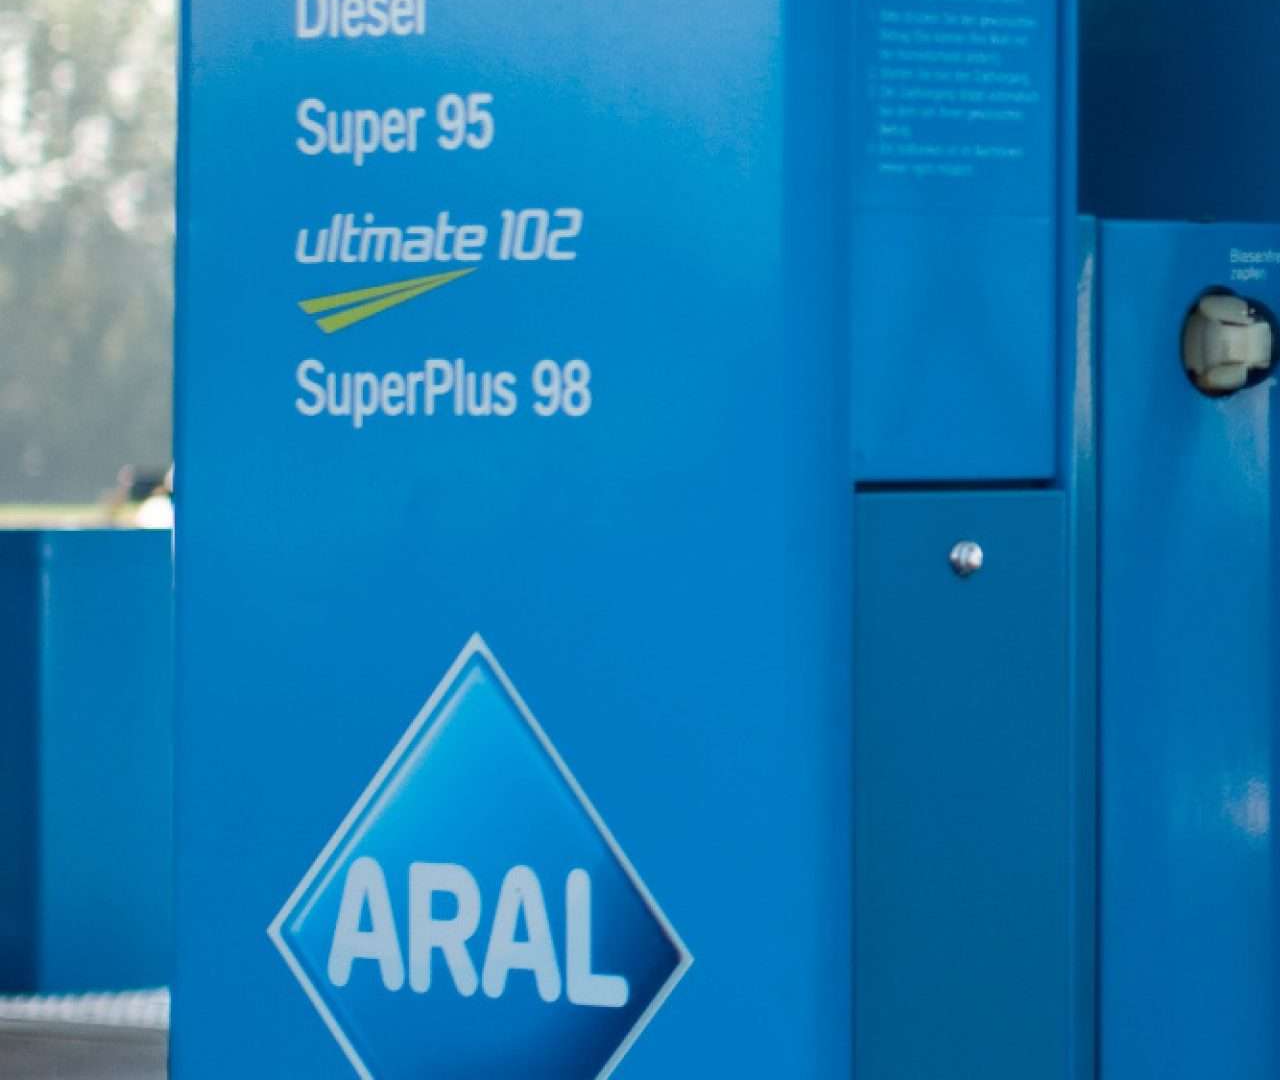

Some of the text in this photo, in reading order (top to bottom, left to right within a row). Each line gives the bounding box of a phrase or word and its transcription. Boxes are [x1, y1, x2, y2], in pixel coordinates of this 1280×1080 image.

[296, 92, 495, 167] Super 95
[295, 208, 584, 264] ultimate 102
[295, 358, 593, 429] SuperPlus 98
[328, 856, 629, 1008] ARAL
